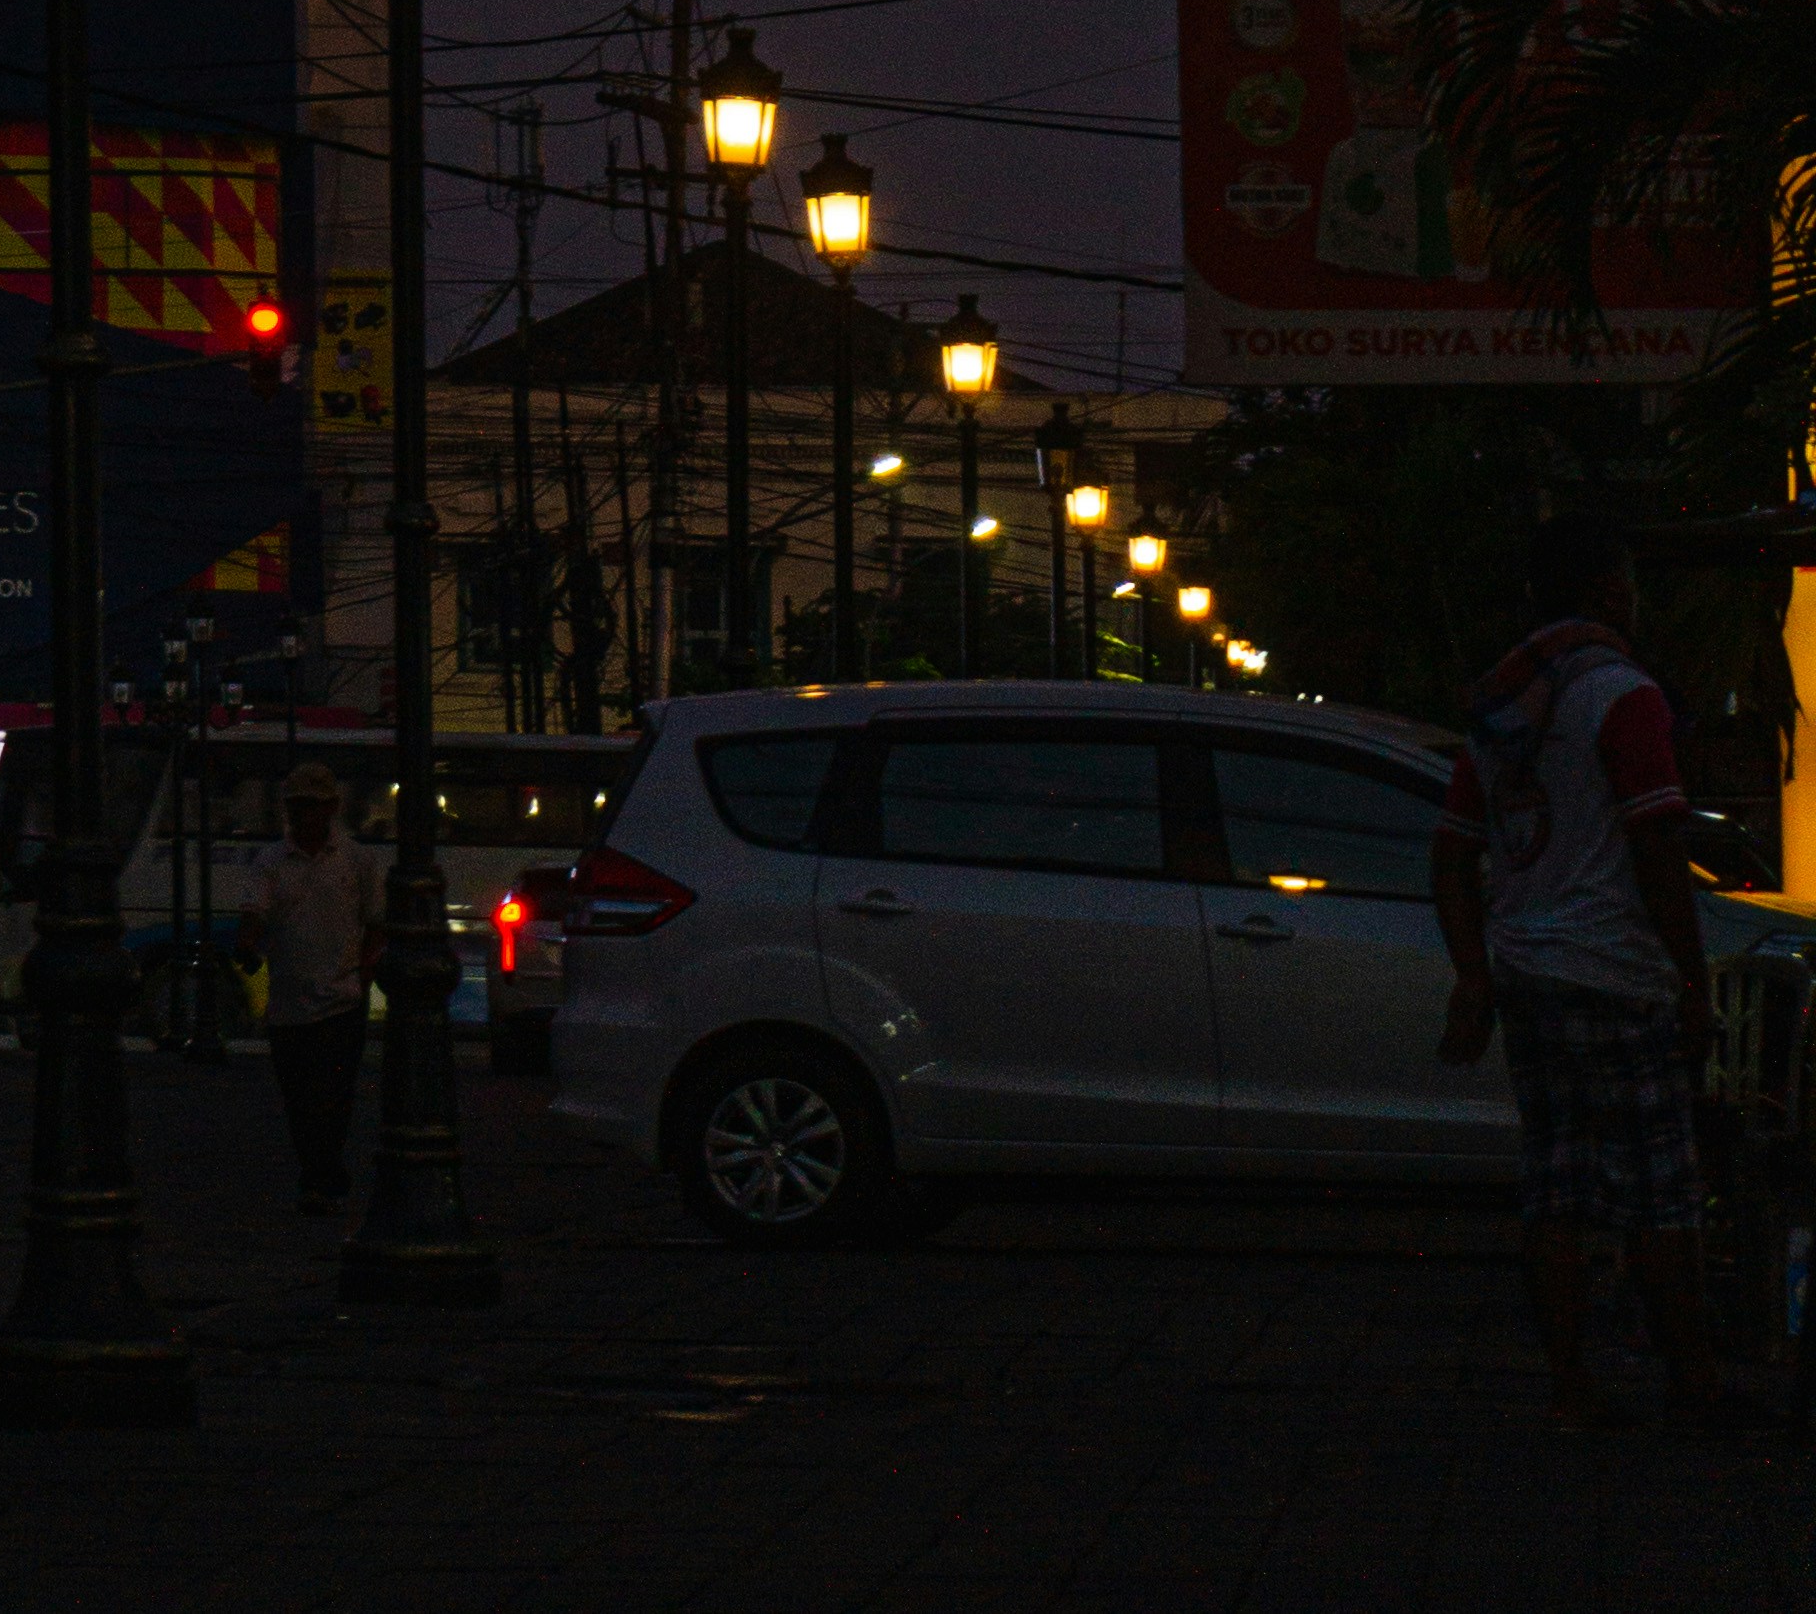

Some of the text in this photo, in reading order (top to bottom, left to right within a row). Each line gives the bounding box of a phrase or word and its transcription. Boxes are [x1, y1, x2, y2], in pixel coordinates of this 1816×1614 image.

[1222, 327, 1693, 358] TOKO SURYA KENCANA
